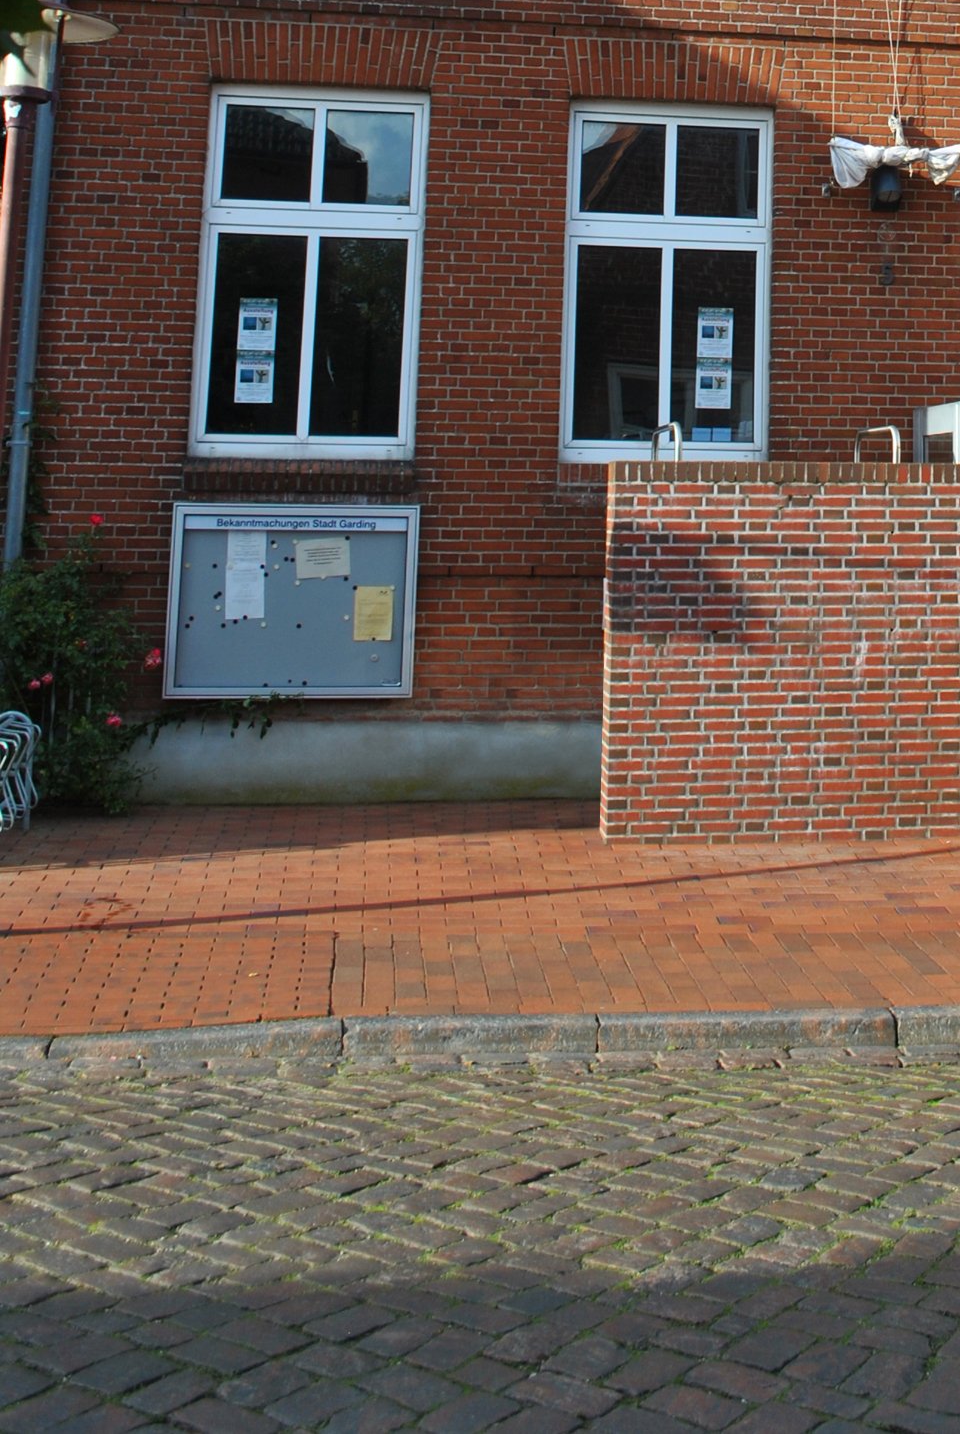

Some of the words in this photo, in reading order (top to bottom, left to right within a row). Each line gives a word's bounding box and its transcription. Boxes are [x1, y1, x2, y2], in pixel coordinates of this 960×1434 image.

[216, 518, 310, 530] Bekanntmachungen
[312, 519, 337, 528] Stadt
[339, 519, 377, 531] Garding
